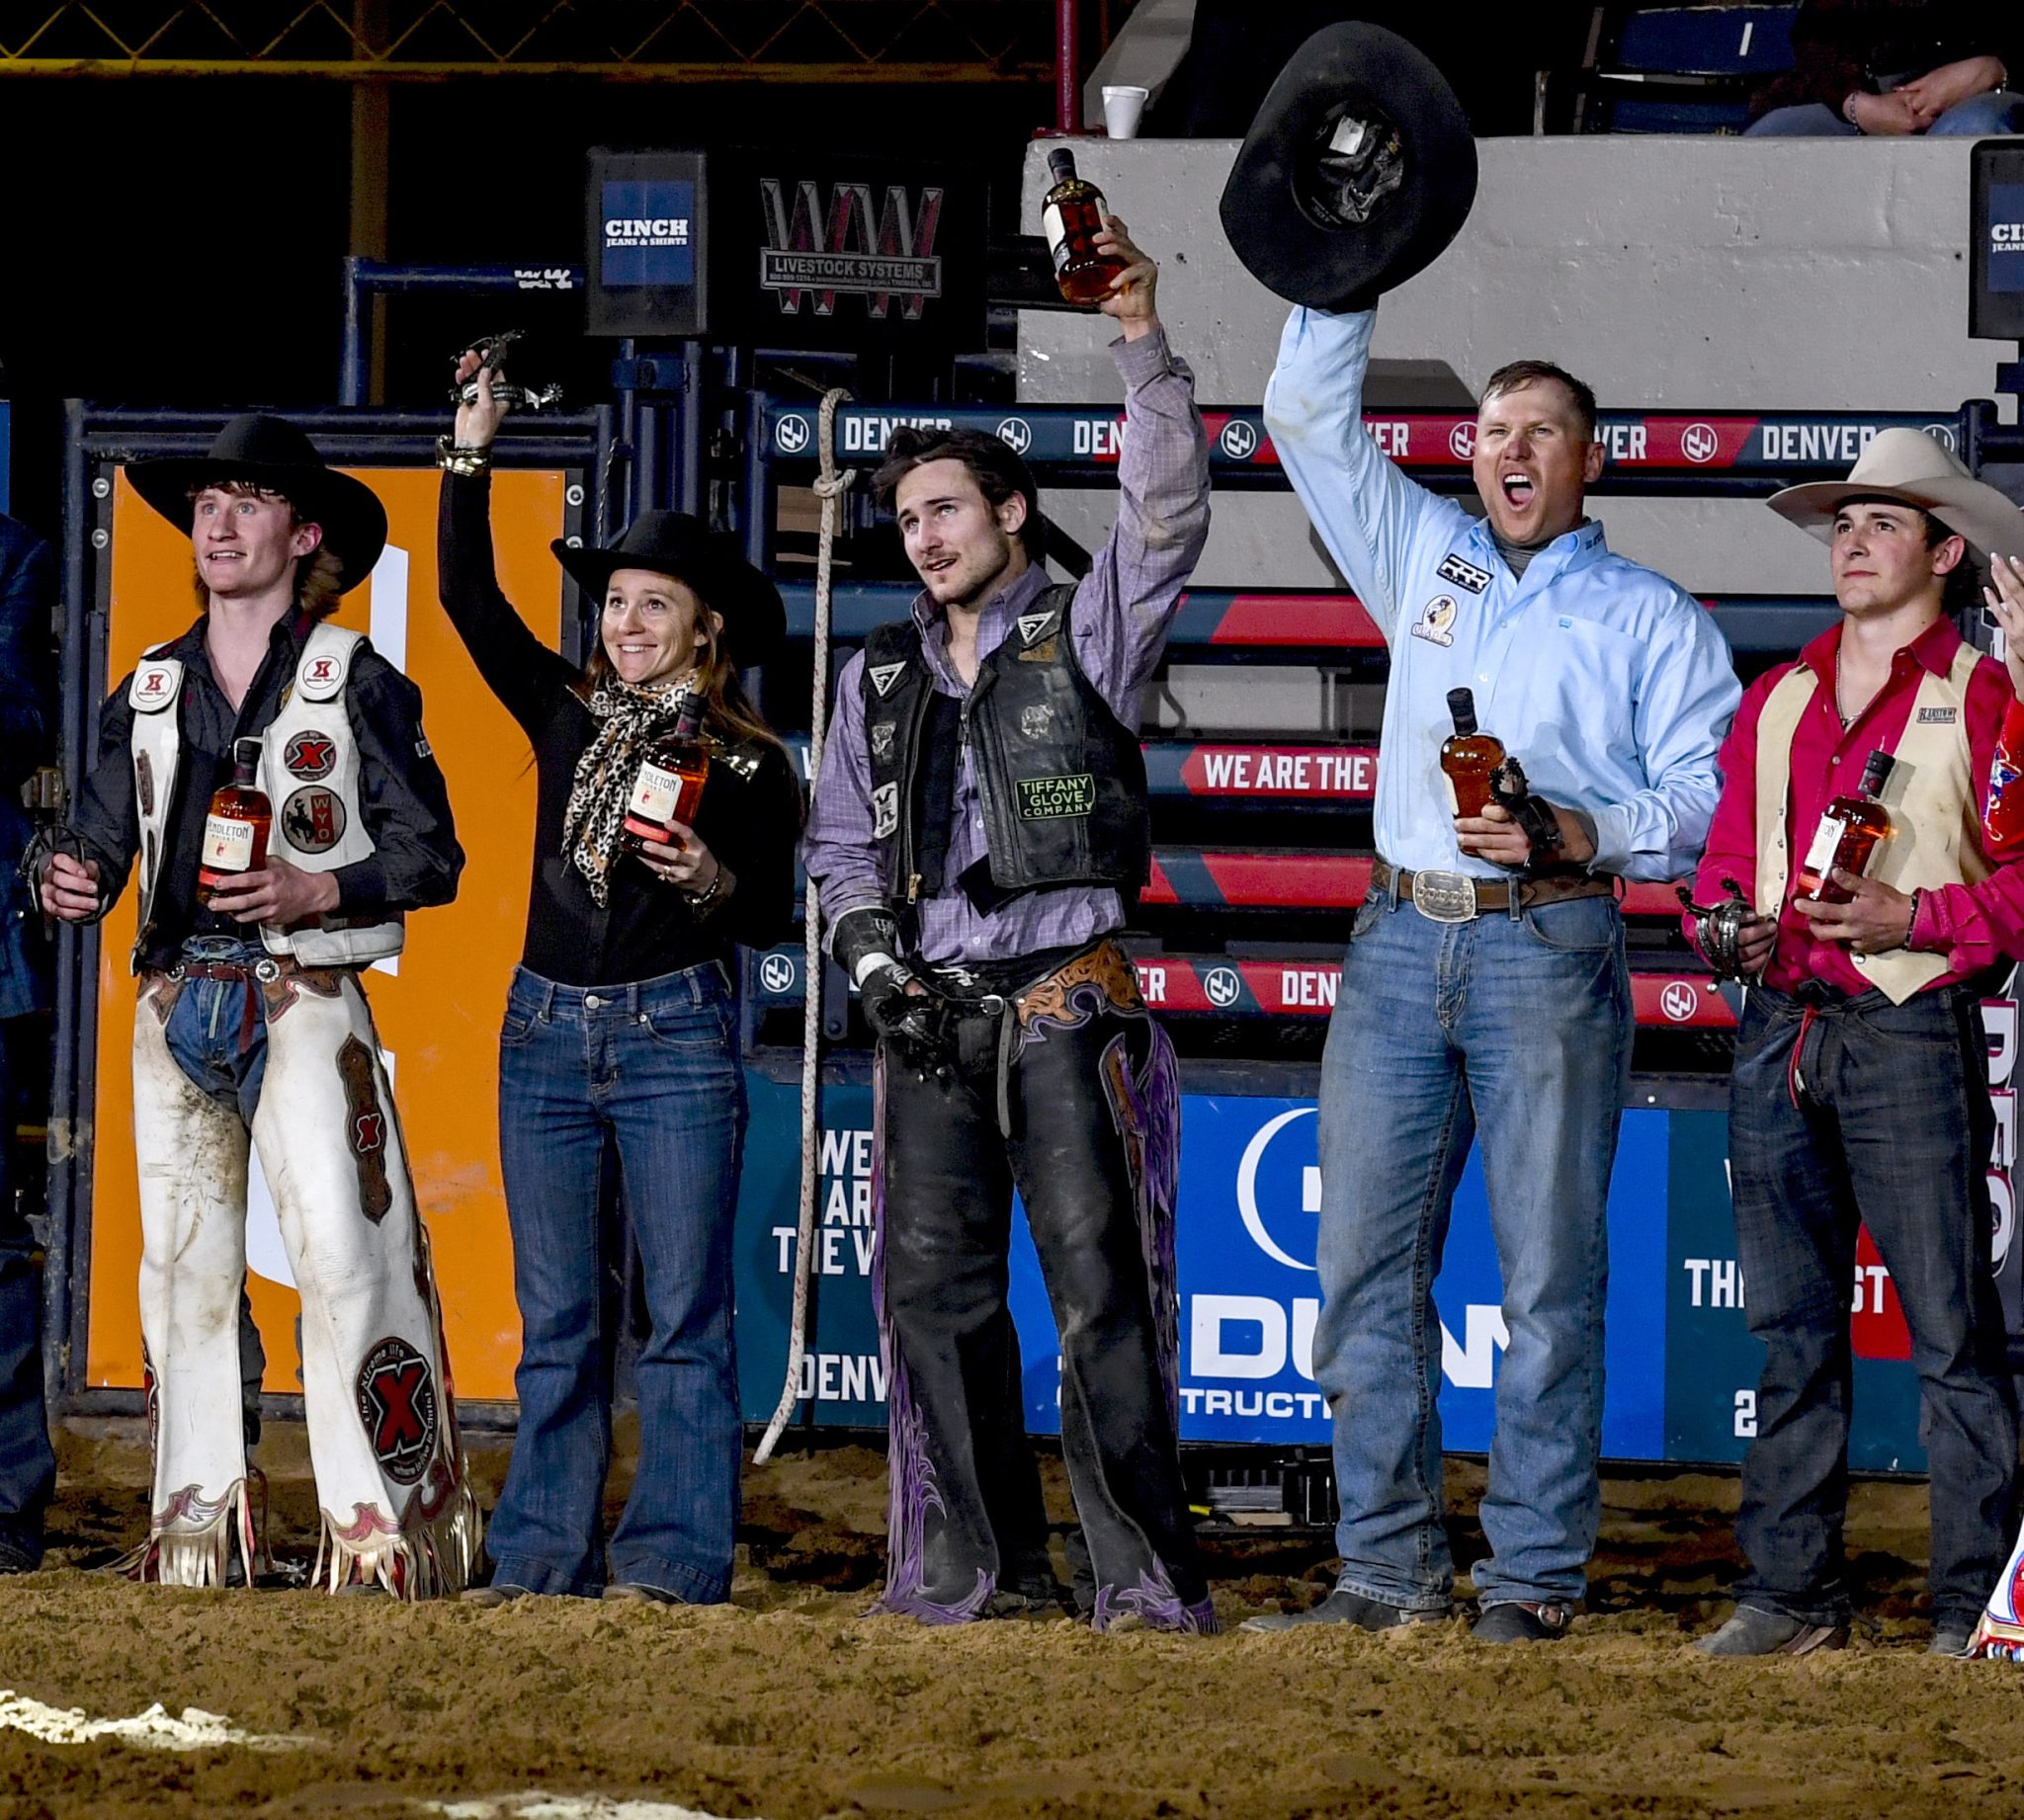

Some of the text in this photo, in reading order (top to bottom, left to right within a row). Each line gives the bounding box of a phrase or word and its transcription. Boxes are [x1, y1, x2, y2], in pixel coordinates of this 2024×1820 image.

[605, 219, 689, 237] CINCH
[606, 237, 637, 247] JEANS
[649, 237, 687, 246] SHIRTS
[1991, 223, 2024, 241] CI
[775, 257, 924, 280] LIVESTOCK SYSTEMS
[845, 417, 952, 451] DEN
[1073, 421, 1127, 455] DEN
[1593, 425, 1646, 459] VER
[1021, 777, 1088, 794] TIFFANY
[1204, 754, 1370, 790] WE ARE THE
[1024, 801, 1092, 818] COMPANY
[1030, 790, 1084, 807] GLOVE
[1282, 970, 1342, 1007] DEN
[824, 1180, 873, 1226] AR
[797, 1355, 888, 1403] DENV
